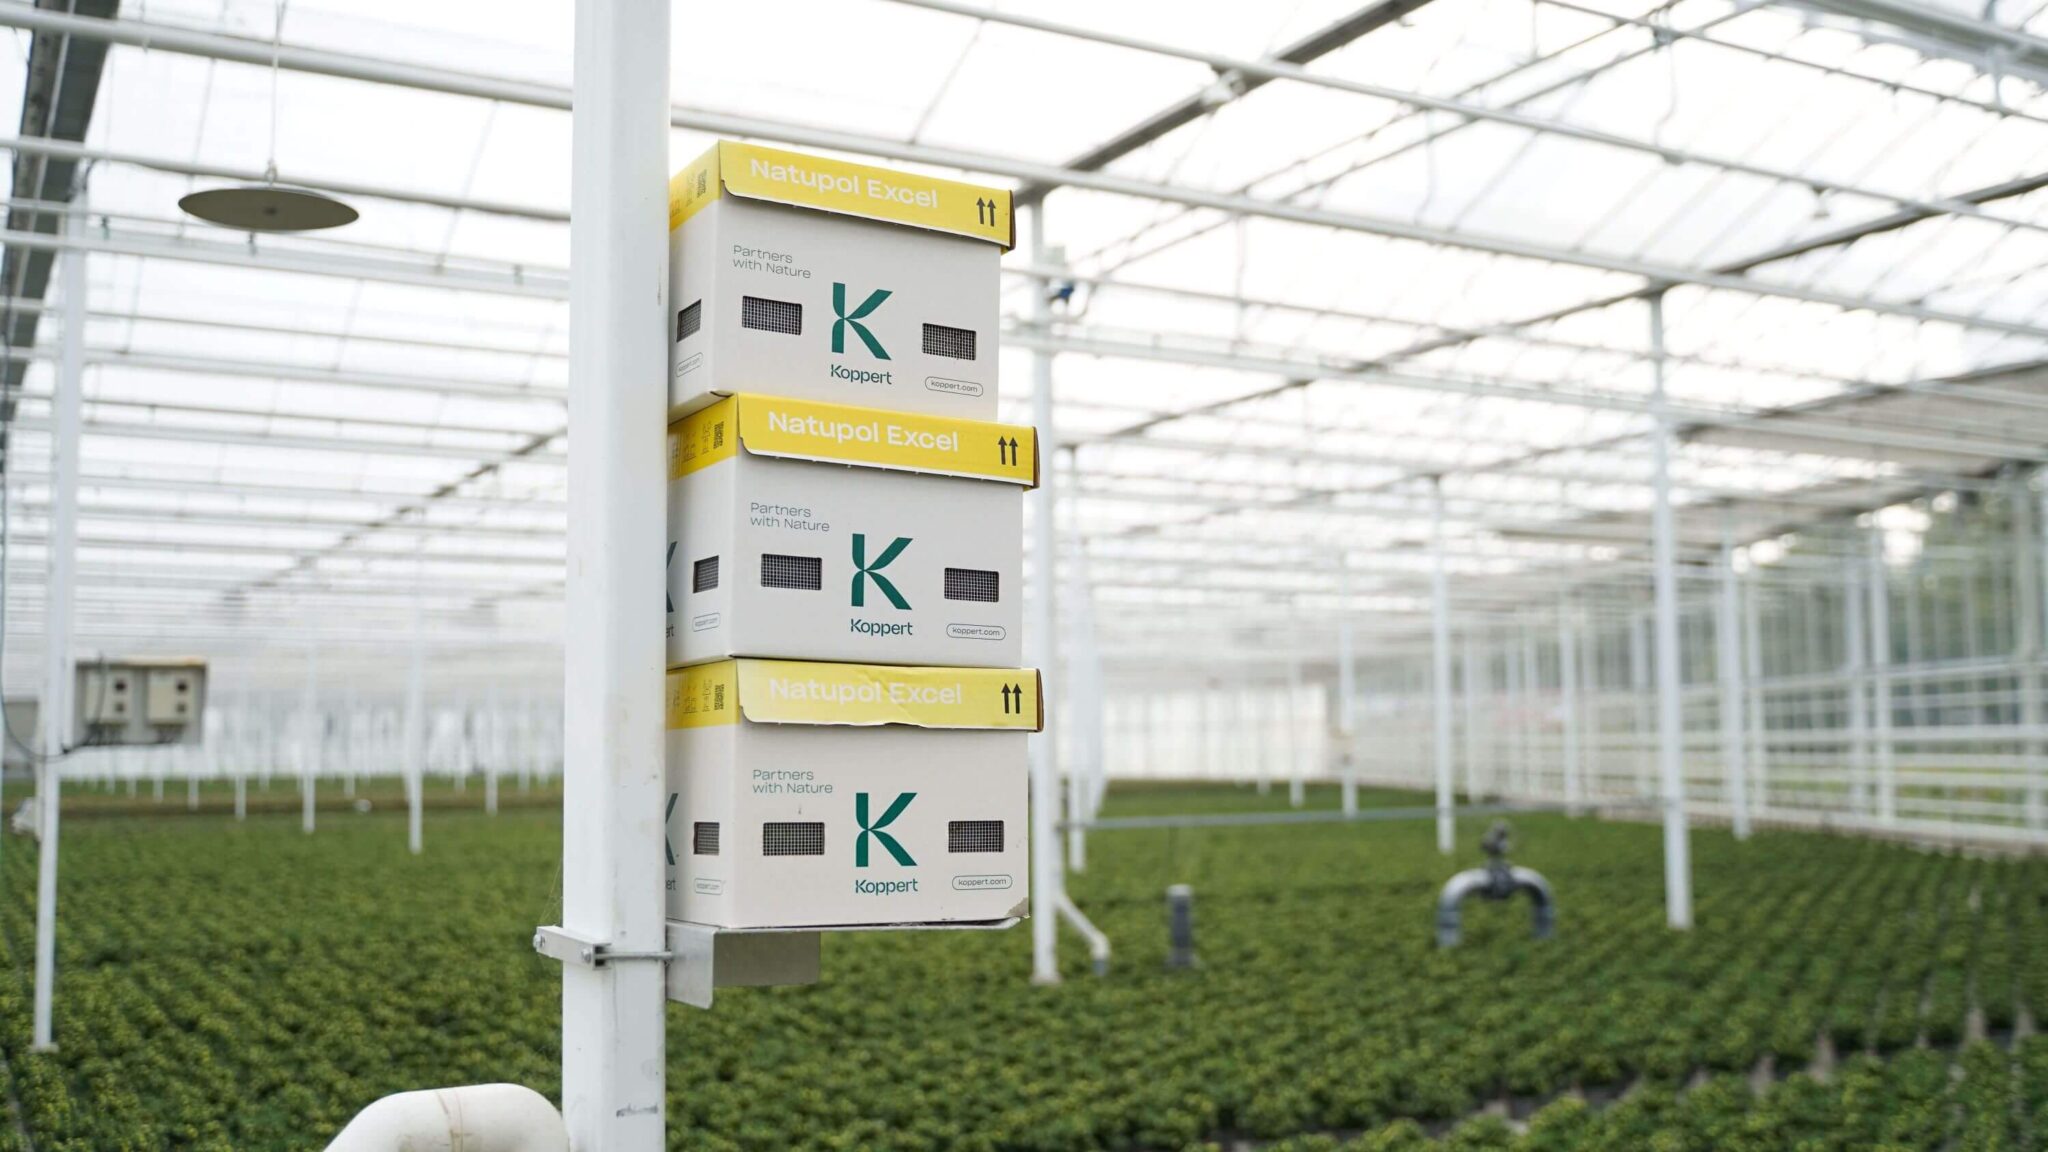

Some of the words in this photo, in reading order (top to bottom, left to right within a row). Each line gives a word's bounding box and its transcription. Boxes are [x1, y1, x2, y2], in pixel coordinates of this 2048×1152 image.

[750, 158, 860, 195] Natupol
[867, 180, 938, 209] Excel
[733, 245, 793, 264] Partners
[733, 258, 762, 272] with
[766, 262, 811, 279] Nature
[830, 364, 892, 385] Koppert
[930, 379, 978, 394] koppert.com
[768, 411, 879, 444] Natupol
[887, 425, 959, 452] Excel
[750, 502, 811, 518] Partners
[750, 515, 780, 528] with
[784, 518, 830, 532] Nature
[850, 618, 913, 637] Koppert
[952, 626, 1000, 639] koppert.com
[769, 678, 881, 706] Natupol
[889, 682, 962, 705] Excel
[753, 769, 814, 781] Partners
[752, 782, 783, 794] with
[786, 782, 833, 794] Nature
[855, 878, 918, 896] Koppert
[958, 877, 1007, 888] koppert.com
